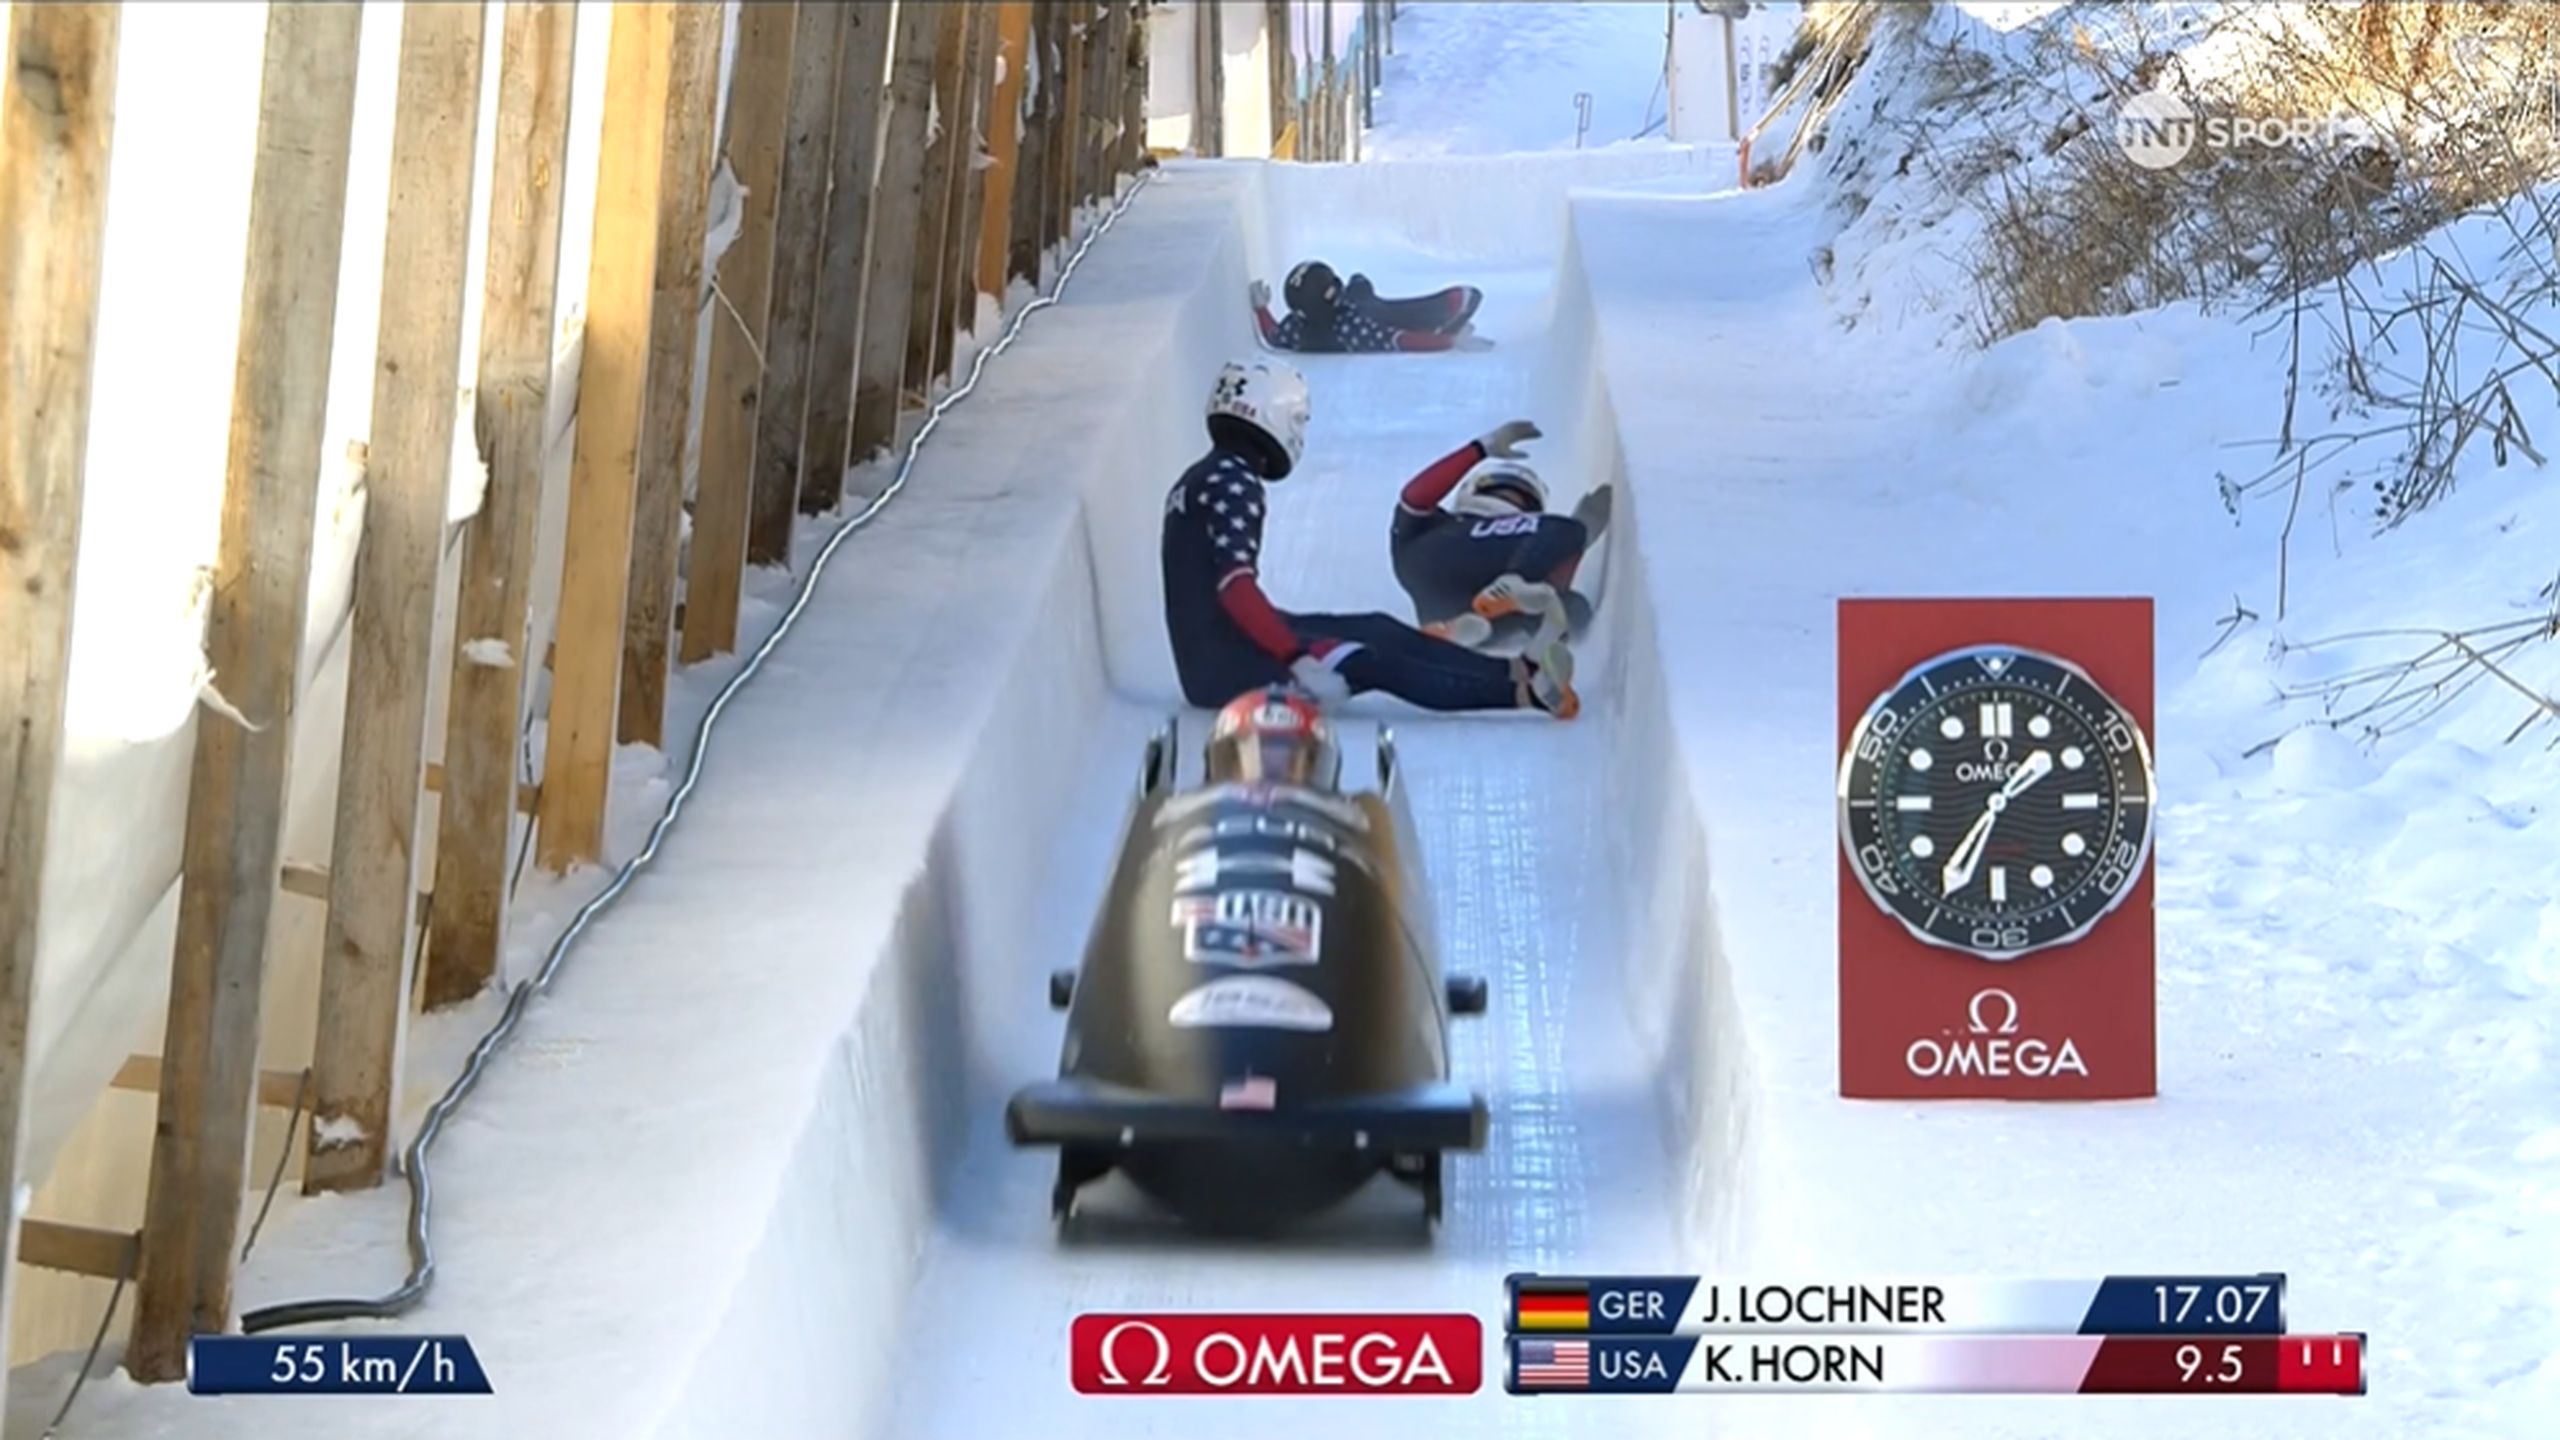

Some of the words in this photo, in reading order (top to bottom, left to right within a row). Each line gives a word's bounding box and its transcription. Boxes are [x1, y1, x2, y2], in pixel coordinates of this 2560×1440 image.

[1470, 515, 1539, 538] USA
[2104, 709, 2133, 752] 10
[2100, 841, 2136, 896] 20
[1906, 1038, 2088, 1076] OMEGA
